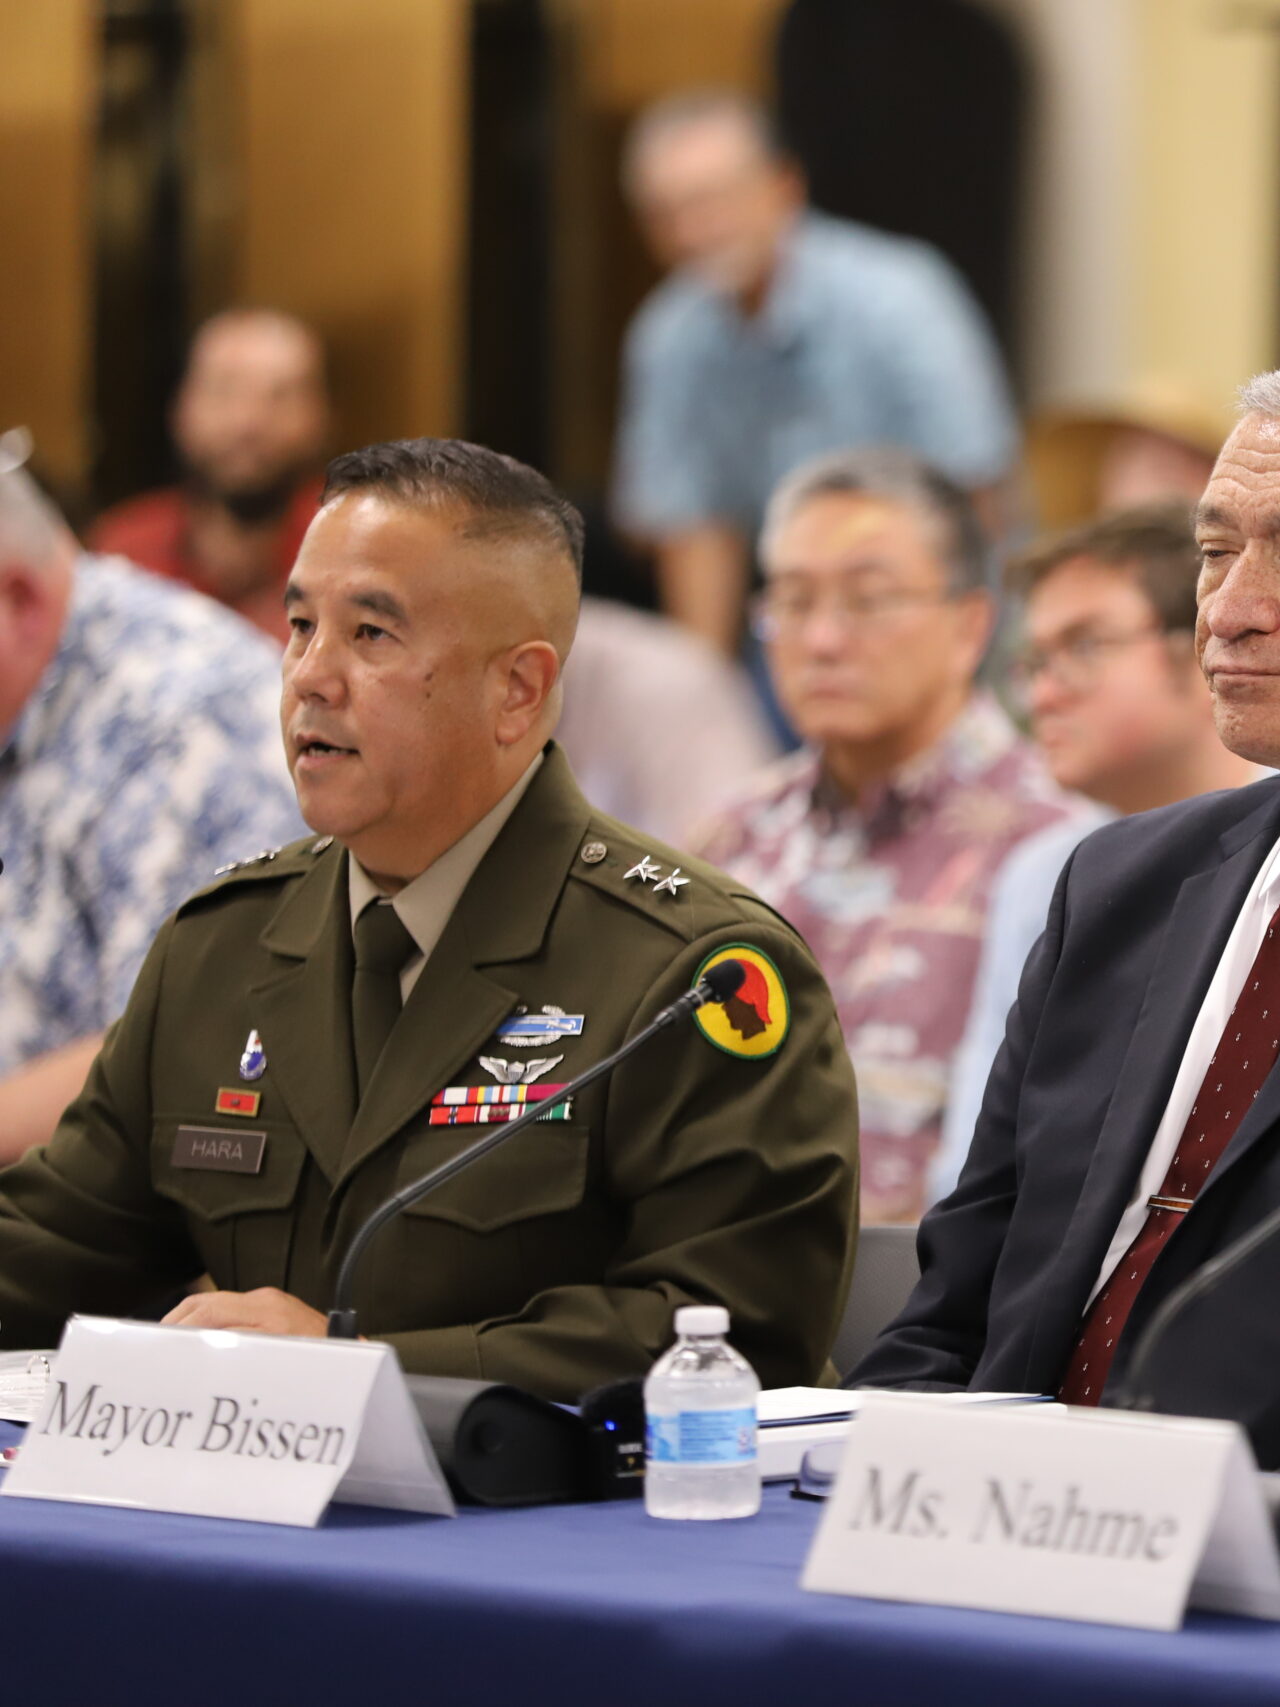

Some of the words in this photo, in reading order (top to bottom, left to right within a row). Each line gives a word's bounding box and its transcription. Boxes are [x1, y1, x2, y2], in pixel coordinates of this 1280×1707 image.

[191, 1138, 244, 1161] HARA
[39, 1380, 193, 1456] Mayor
[196, 1396, 346, 1466] Bissen
[847, 1466, 949, 1541] Ms.
[968, 1476, 1182, 1563] Nahme
